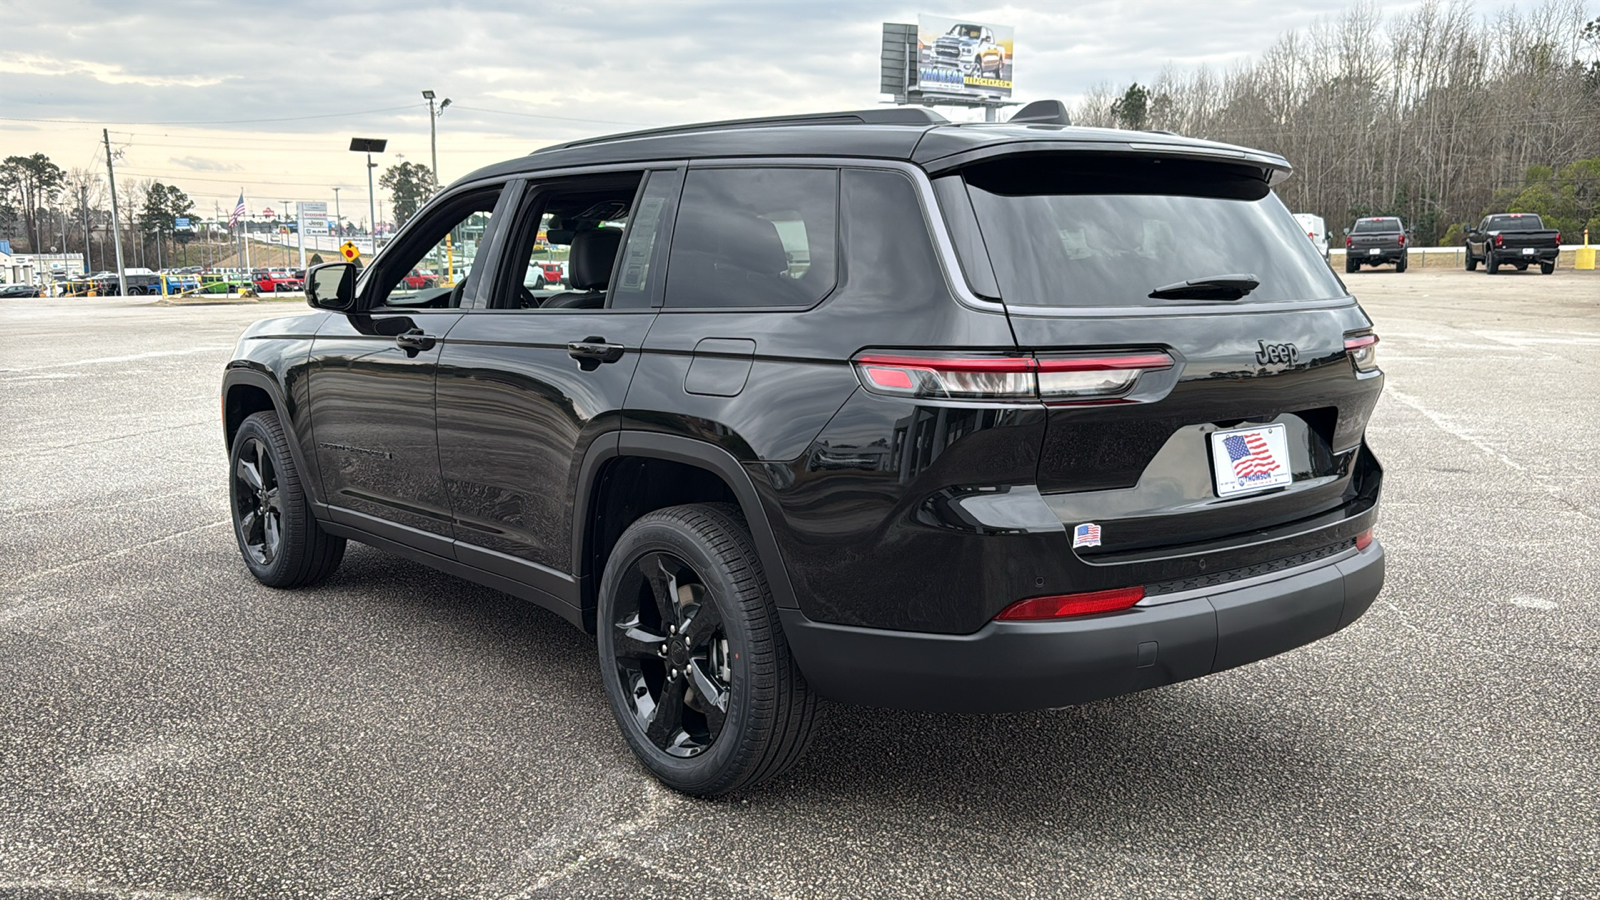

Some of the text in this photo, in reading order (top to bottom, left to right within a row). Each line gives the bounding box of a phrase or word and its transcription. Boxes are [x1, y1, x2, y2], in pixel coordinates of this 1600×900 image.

[920, 68, 964, 84] THOMSON
[1254, 339, 1300, 368] Jeep
[1245, 472, 1272, 482] THOMSON
